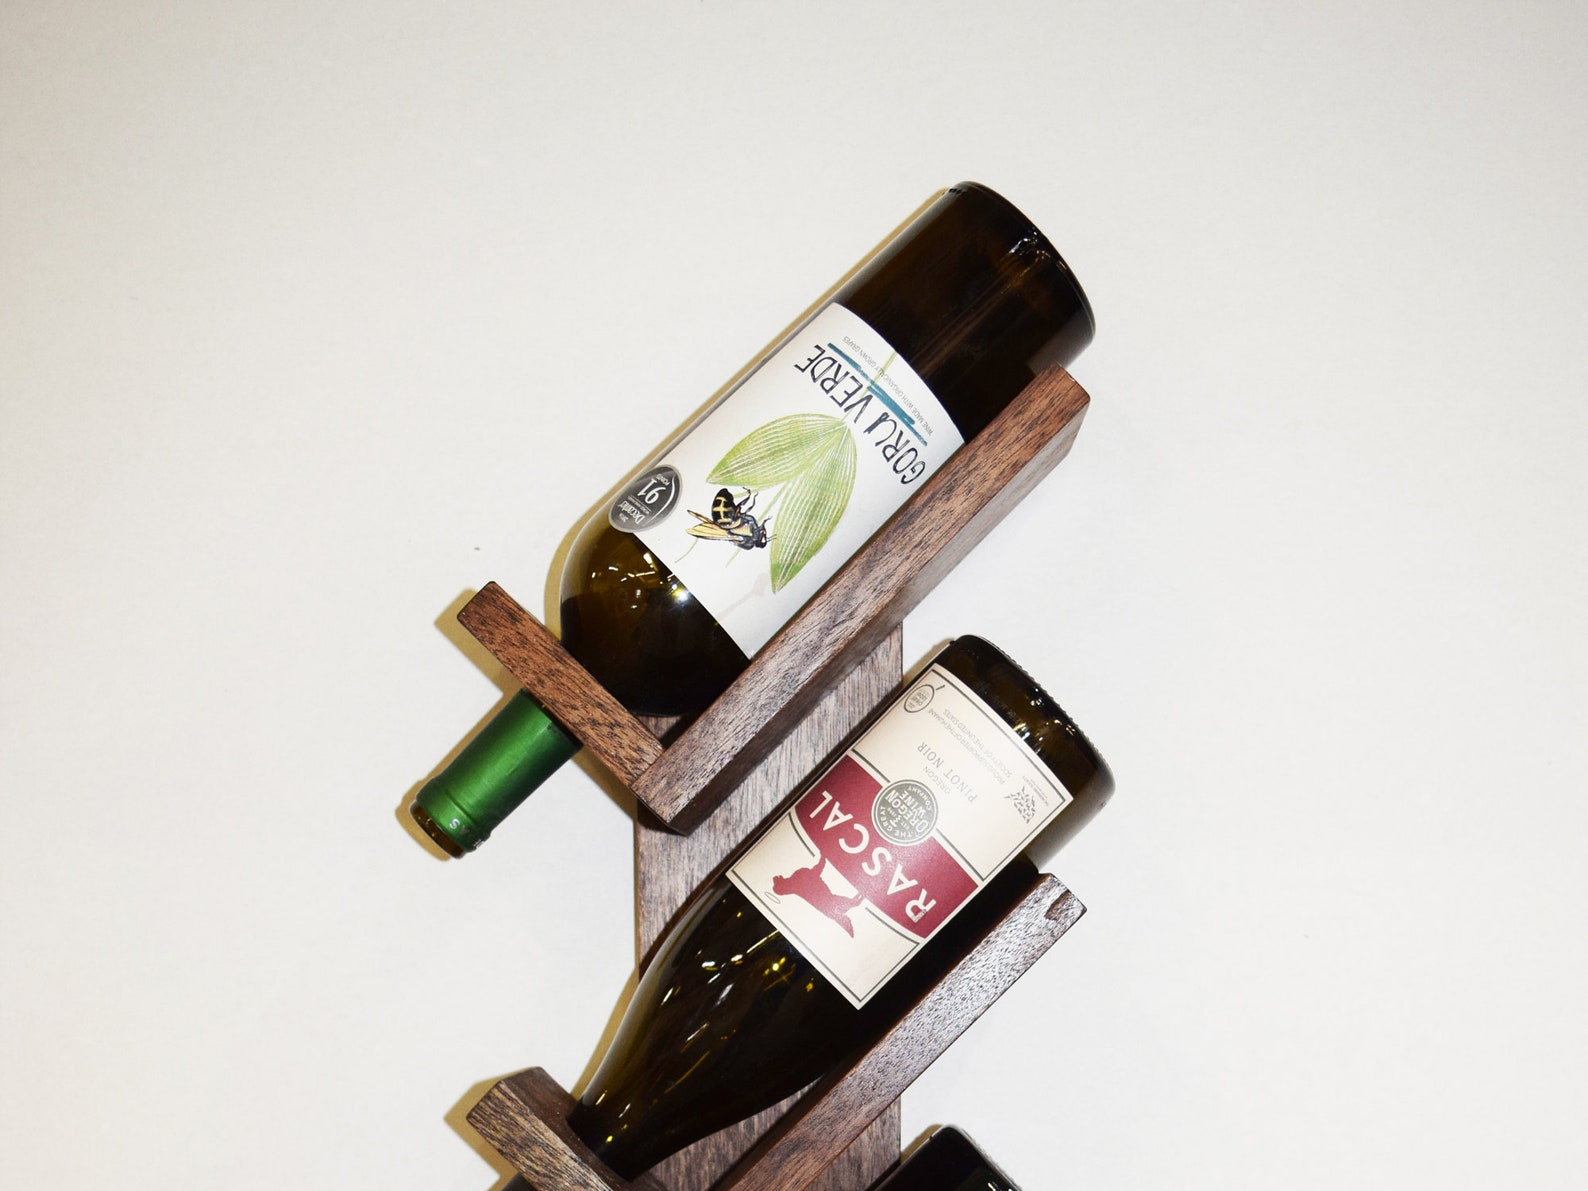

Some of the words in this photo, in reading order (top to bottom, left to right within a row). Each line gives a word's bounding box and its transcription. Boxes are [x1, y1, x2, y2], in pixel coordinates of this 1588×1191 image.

[842, 335, 861, 353] GRAPES
[857, 349, 876, 368] GROWN
[794, 343, 873, 424] VERDE
[873, 365, 904, 397] ORGANICALLY
[900, 394, 914, 409] WITH
[910, 406, 925, 423] MADE
[921, 420, 933, 435] WINE
[863, 411, 925, 485] GORU
[636, 477, 666, 505] 91
[955, 721, 976, 742] UNITED
[971, 738, 985, 751] THE
[916, 740, 944, 768] NOIR
[922, 765, 952, 795] OREGON
[943, 767, 978, 803] PINOT
[884, 789, 930, 834] OREGON
[898, 789, 927, 819] WINE
[907, 785, 932, 810] COMPANY
[879, 805, 892, 832] GREAT
[809, 790, 937, 923] RASCAL
